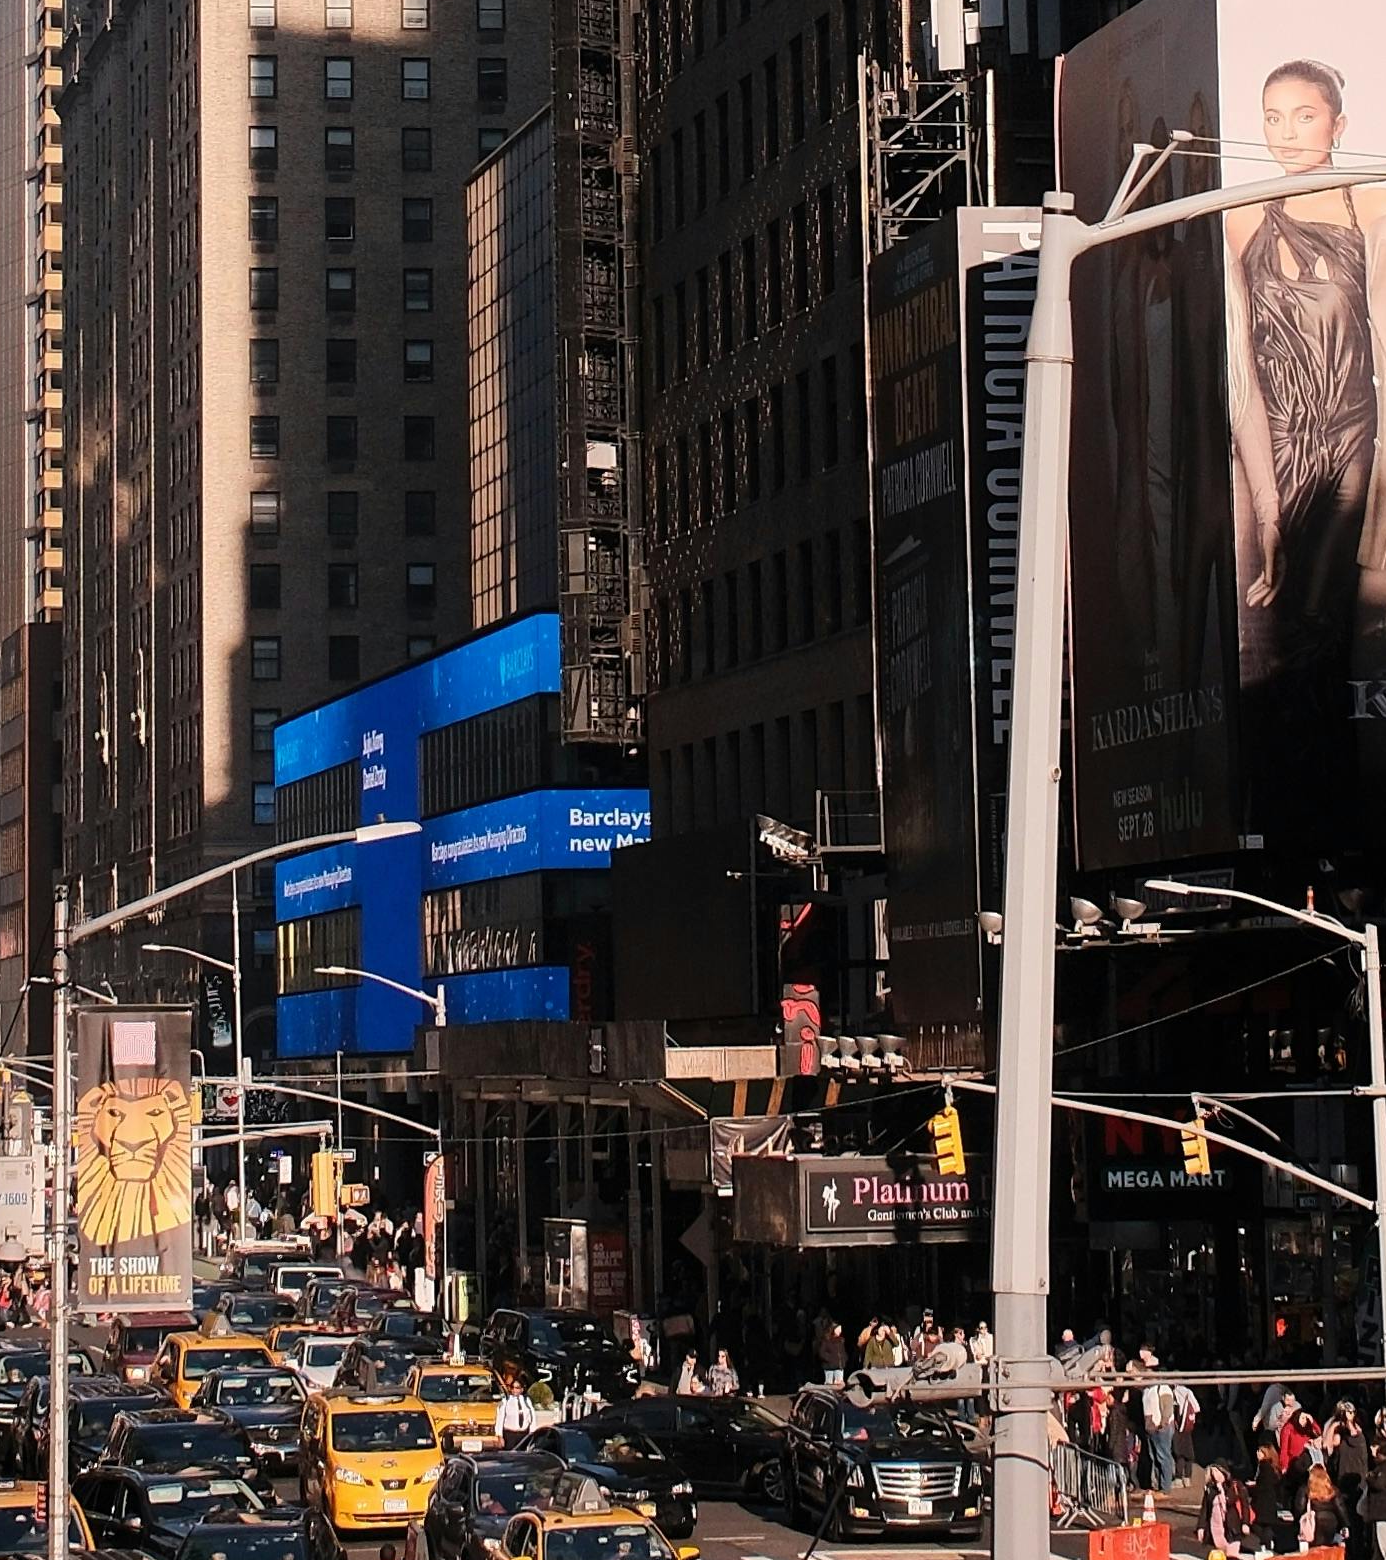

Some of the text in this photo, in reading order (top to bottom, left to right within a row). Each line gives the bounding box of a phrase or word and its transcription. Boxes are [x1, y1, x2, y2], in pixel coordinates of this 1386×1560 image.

[1092, 686, 1224, 752] KARDASHIANS
[570, 808, 651, 830] Barclays
[1118, 812, 1140, 842] SEPT
[570, 837, 612, 852] new
[1107, 1169, 1226, 1188] MEGA MART
[933, 1207, 958, 1221] Club
[89, 1256, 160, 1275] THE SHOW
[89, 1275, 182, 1295] OF A LIFETIME
